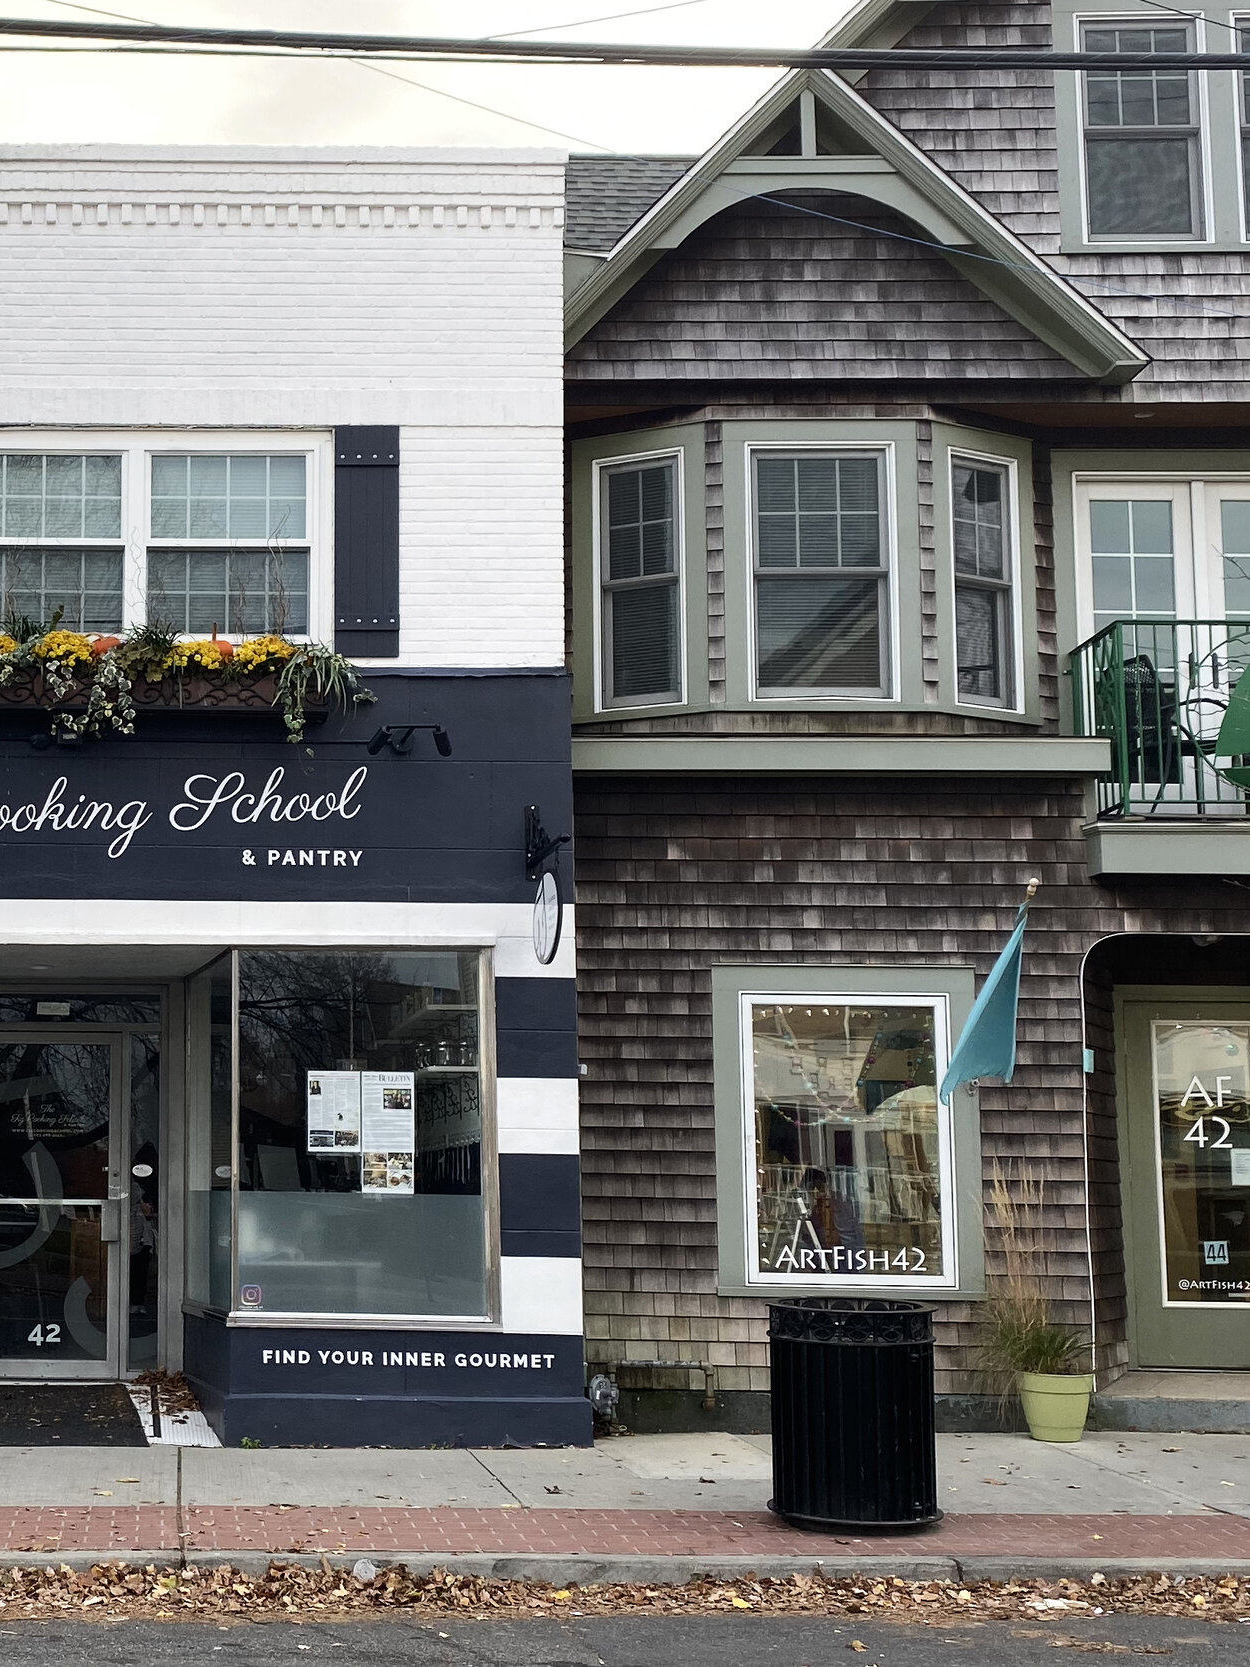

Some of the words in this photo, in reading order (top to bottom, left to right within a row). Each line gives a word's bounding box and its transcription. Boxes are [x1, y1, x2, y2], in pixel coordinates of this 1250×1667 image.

[168, 766, 368, 832] School
[242, 849, 257, 866] &
[268, 849, 363, 867] PANTRY
[1180, 1074, 1232, 1108] AF
[1183, 1115, 1233, 1149] 42
[775, 1244, 927, 1272] ARTFISH42
[1206, 1244, 1227, 1261] 44
[28, 1323, 61, 1346] 42
[262, 1349, 311, 1364] FIND
[317, 1350, 374, 1366] YOUR
[382, 1351, 446, 1366] INNER
[454, 1353, 555, 1369] GOURMET
